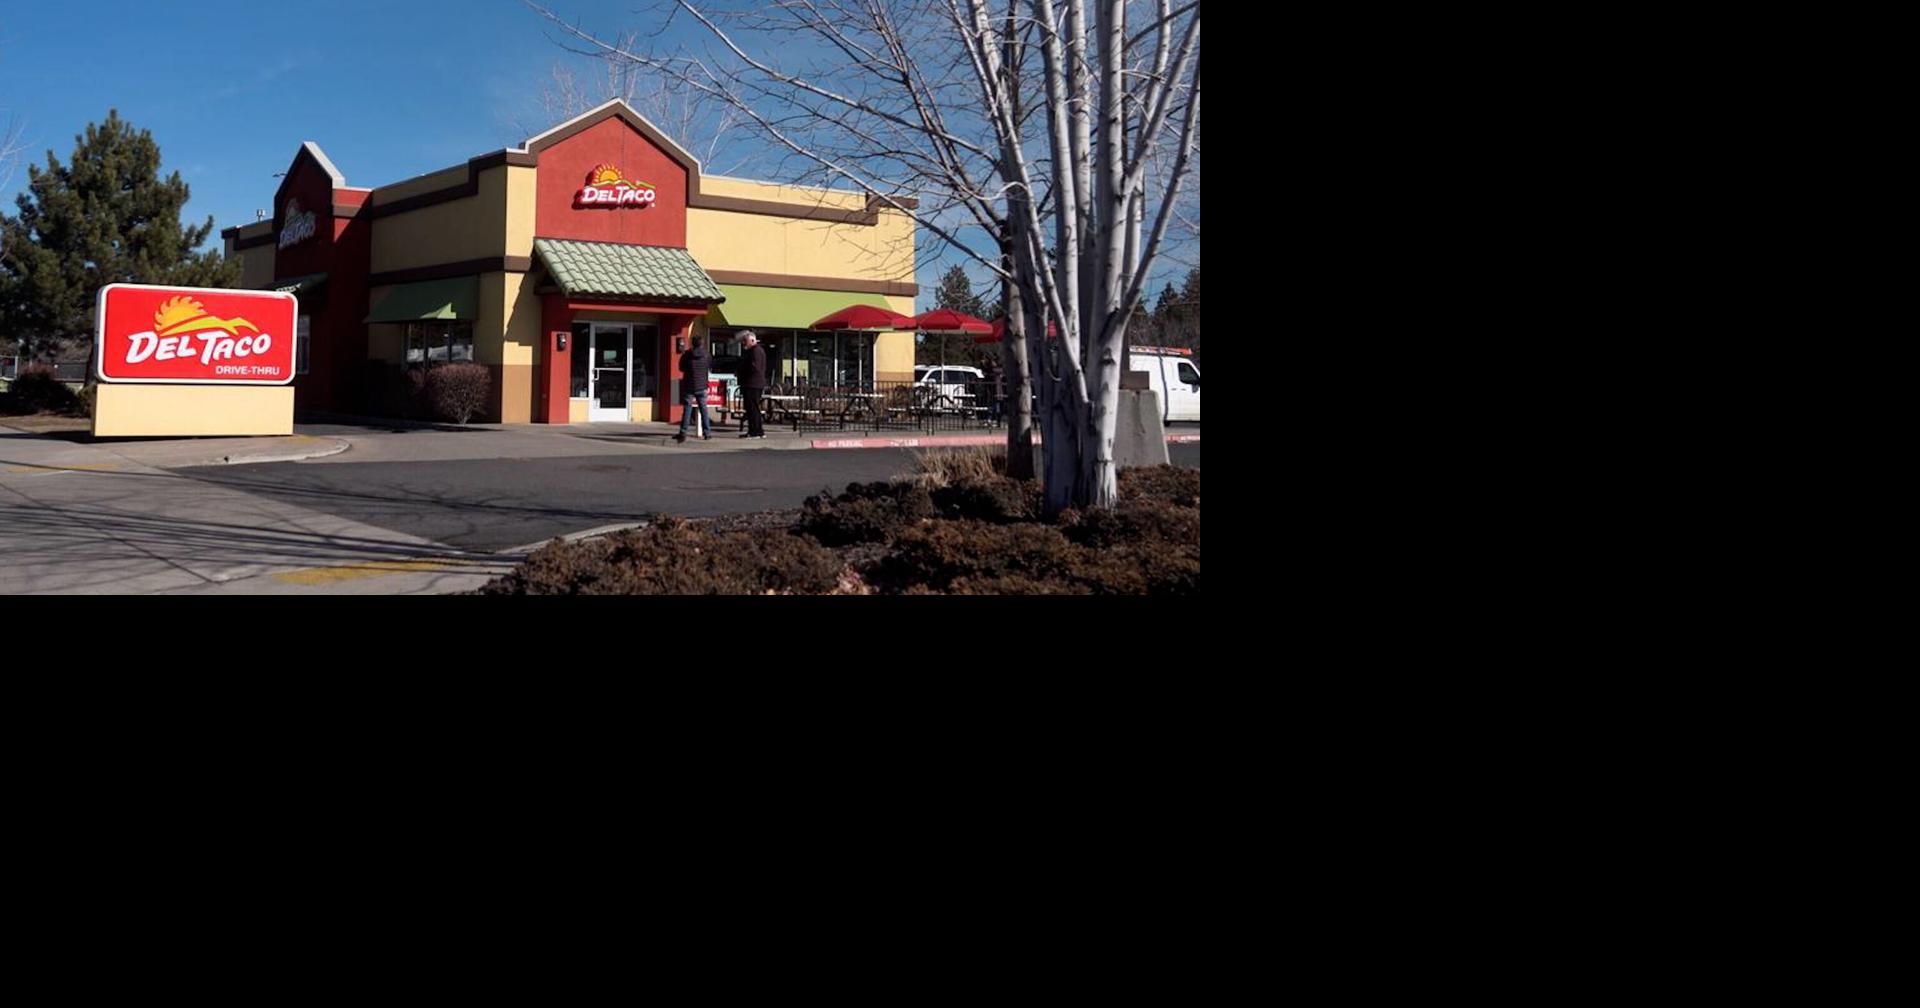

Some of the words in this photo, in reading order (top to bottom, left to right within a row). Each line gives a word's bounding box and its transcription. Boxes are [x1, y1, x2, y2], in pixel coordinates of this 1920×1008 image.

[582, 186, 617, 203] DEL
[615, 185, 656, 204] TACO
[125, 331, 197, 364] DEL
[196, 330, 272, 366] TACO
[215, 365, 280, 376] DRIVE-THRU
